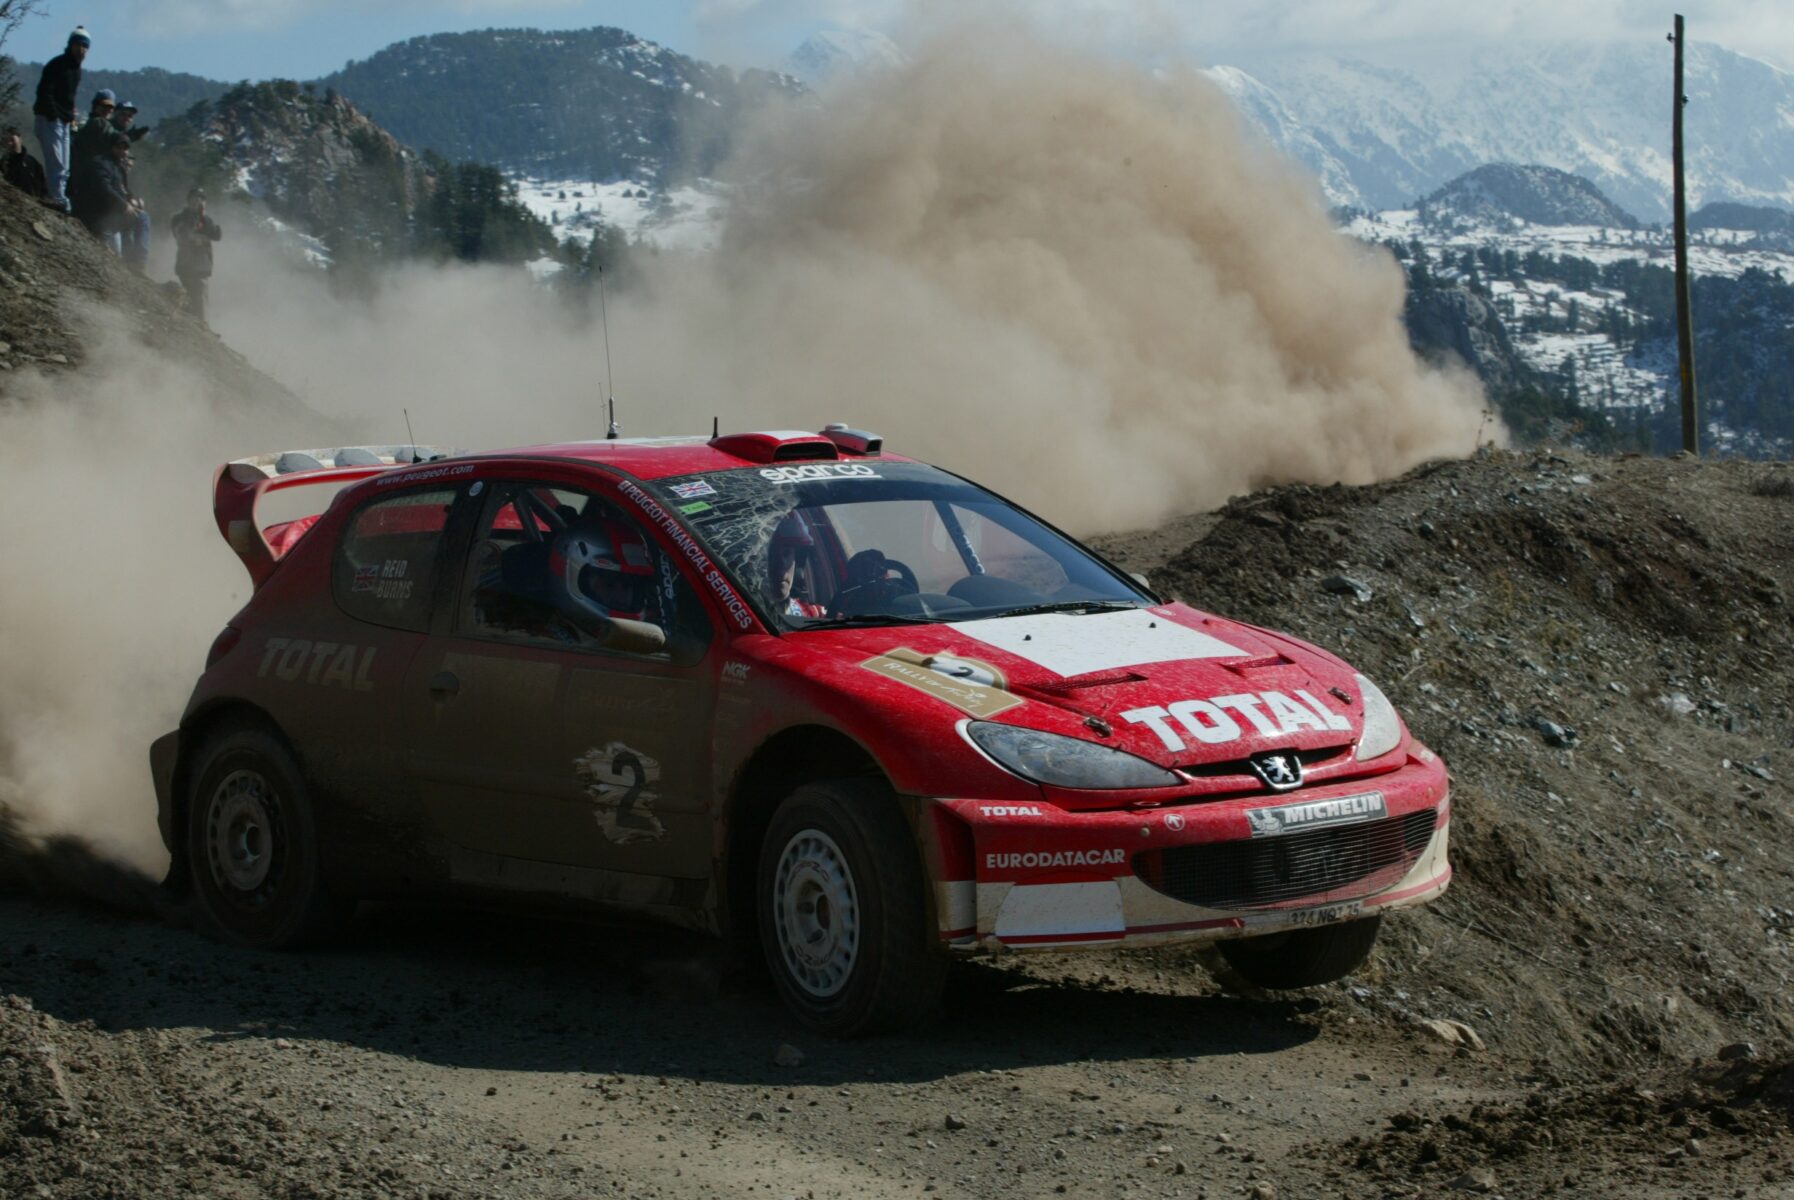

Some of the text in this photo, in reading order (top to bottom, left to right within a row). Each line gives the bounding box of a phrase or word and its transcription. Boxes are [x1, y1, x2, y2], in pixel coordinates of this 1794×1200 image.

[376, 464, 476, 486] www.peugeot.com
[760, 464, 877, 483] sparco
[624, 484, 668, 523] PEUGEOT
[661, 516, 710, 573] FINANCIAL
[705, 570, 753, 629] SERVICES
[382, 559, 409, 578] REID
[257, 637, 378, 692] TOTAL
[722, 661, 751, 680] NGK
[1119, 690, 1353, 752] TOTAL
[611, 751, 653, 830] 2
[979, 806, 1043, 817] TOTAL
[1283, 794, 1383, 824] MICHELIN
[985, 849, 1126, 869] EURODATACAR
